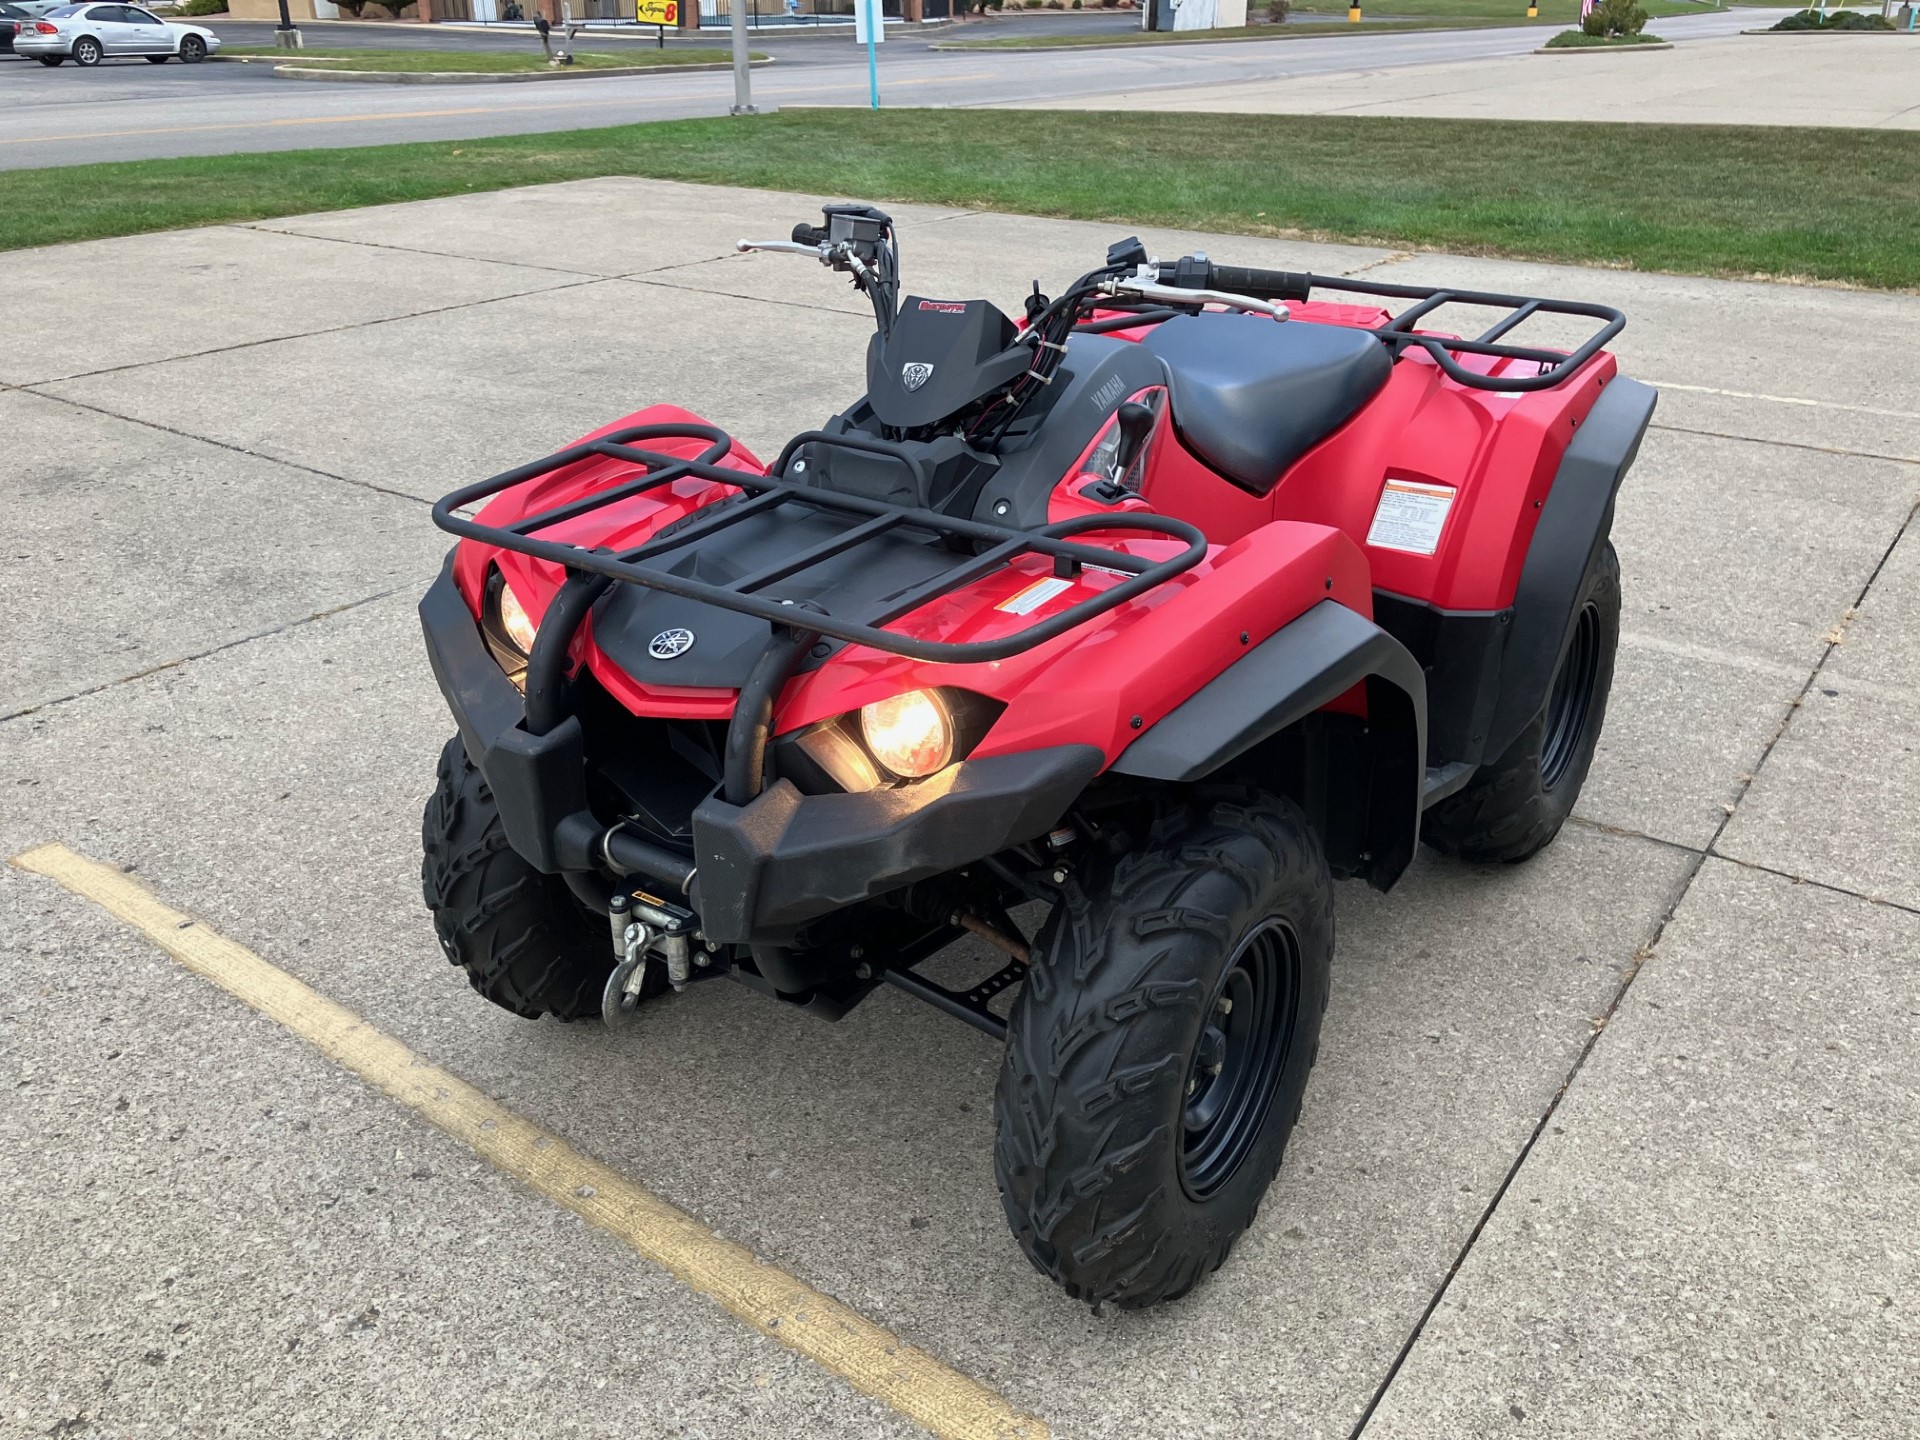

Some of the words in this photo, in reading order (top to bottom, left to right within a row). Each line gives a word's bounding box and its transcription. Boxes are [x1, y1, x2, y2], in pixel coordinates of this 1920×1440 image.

[645, 2, 665, 17] Super
[664, 3, 676, 22] 8
[1091, 374, 1126, 410] YAMAHA
